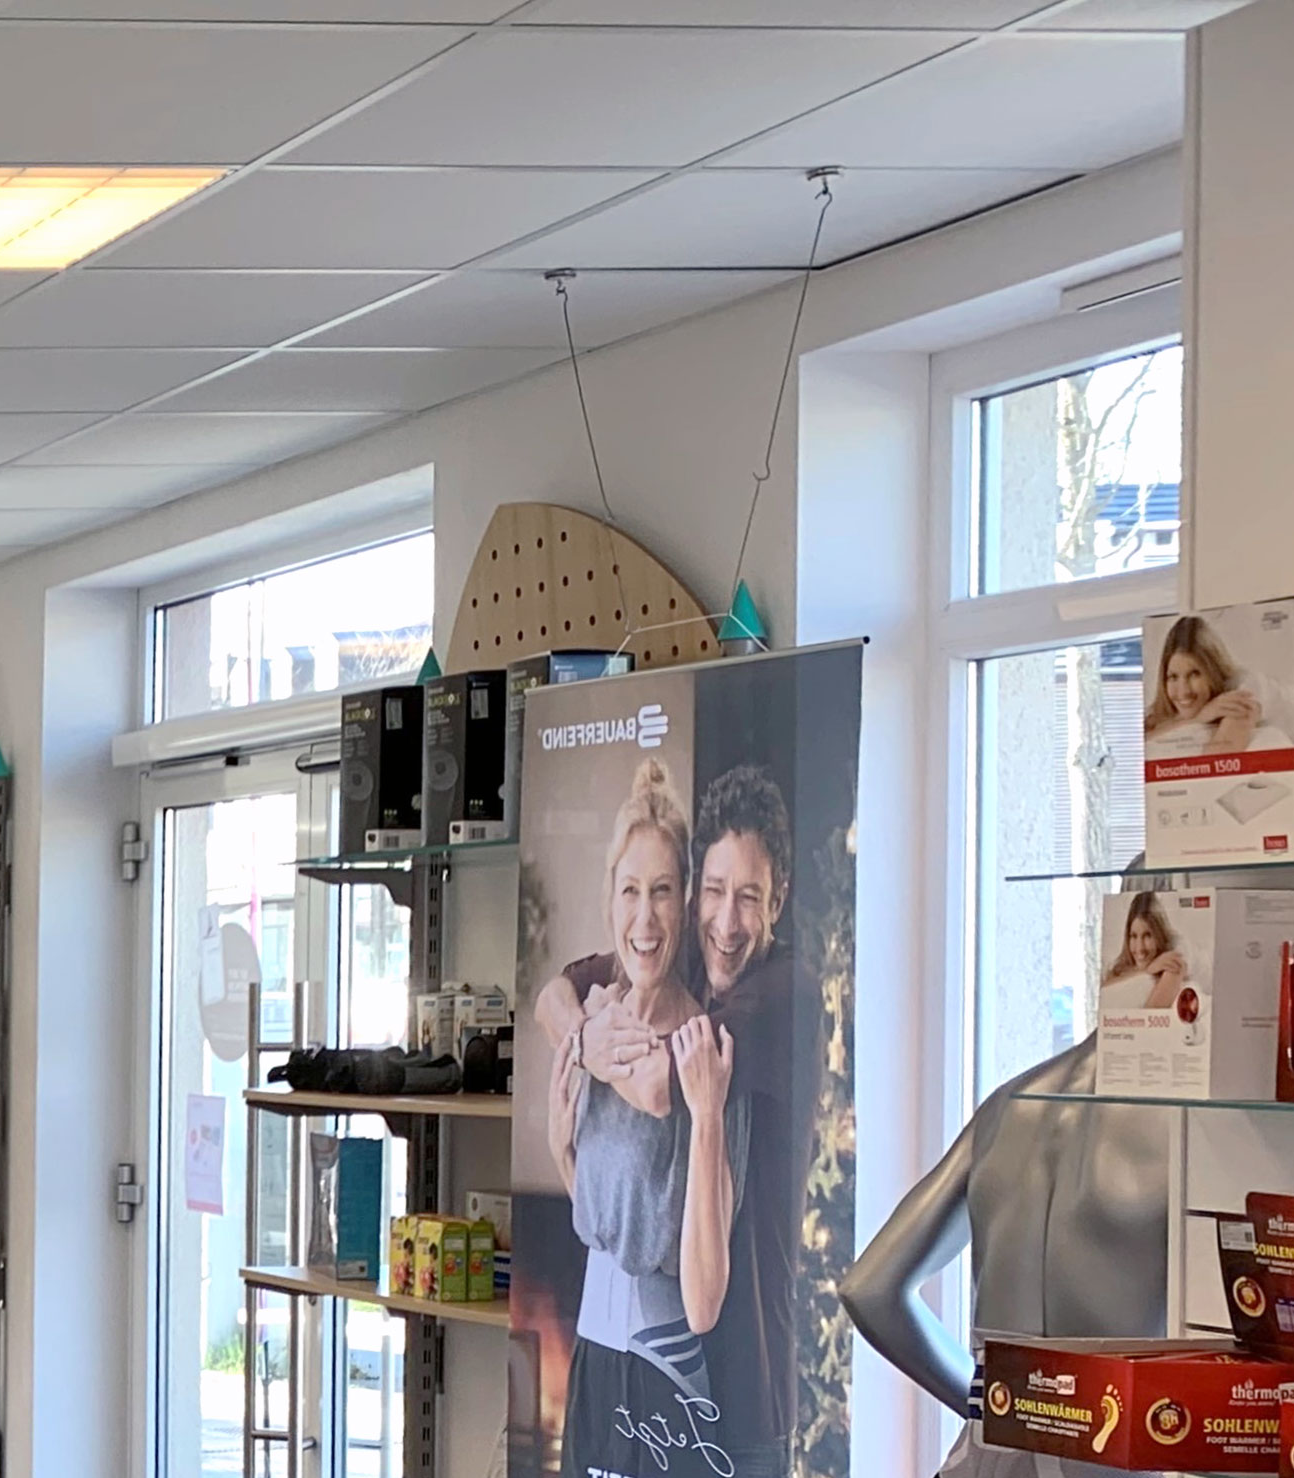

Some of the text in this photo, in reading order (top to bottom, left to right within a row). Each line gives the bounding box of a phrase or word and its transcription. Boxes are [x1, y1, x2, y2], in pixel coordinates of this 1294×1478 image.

[1155, 758, 1241, 778] bosotherm 1500
[1102, 1015, 1170, 1028] bosotherm 5000
[1014, 1397, 1092, 1423] SOHLENWÄRMER
